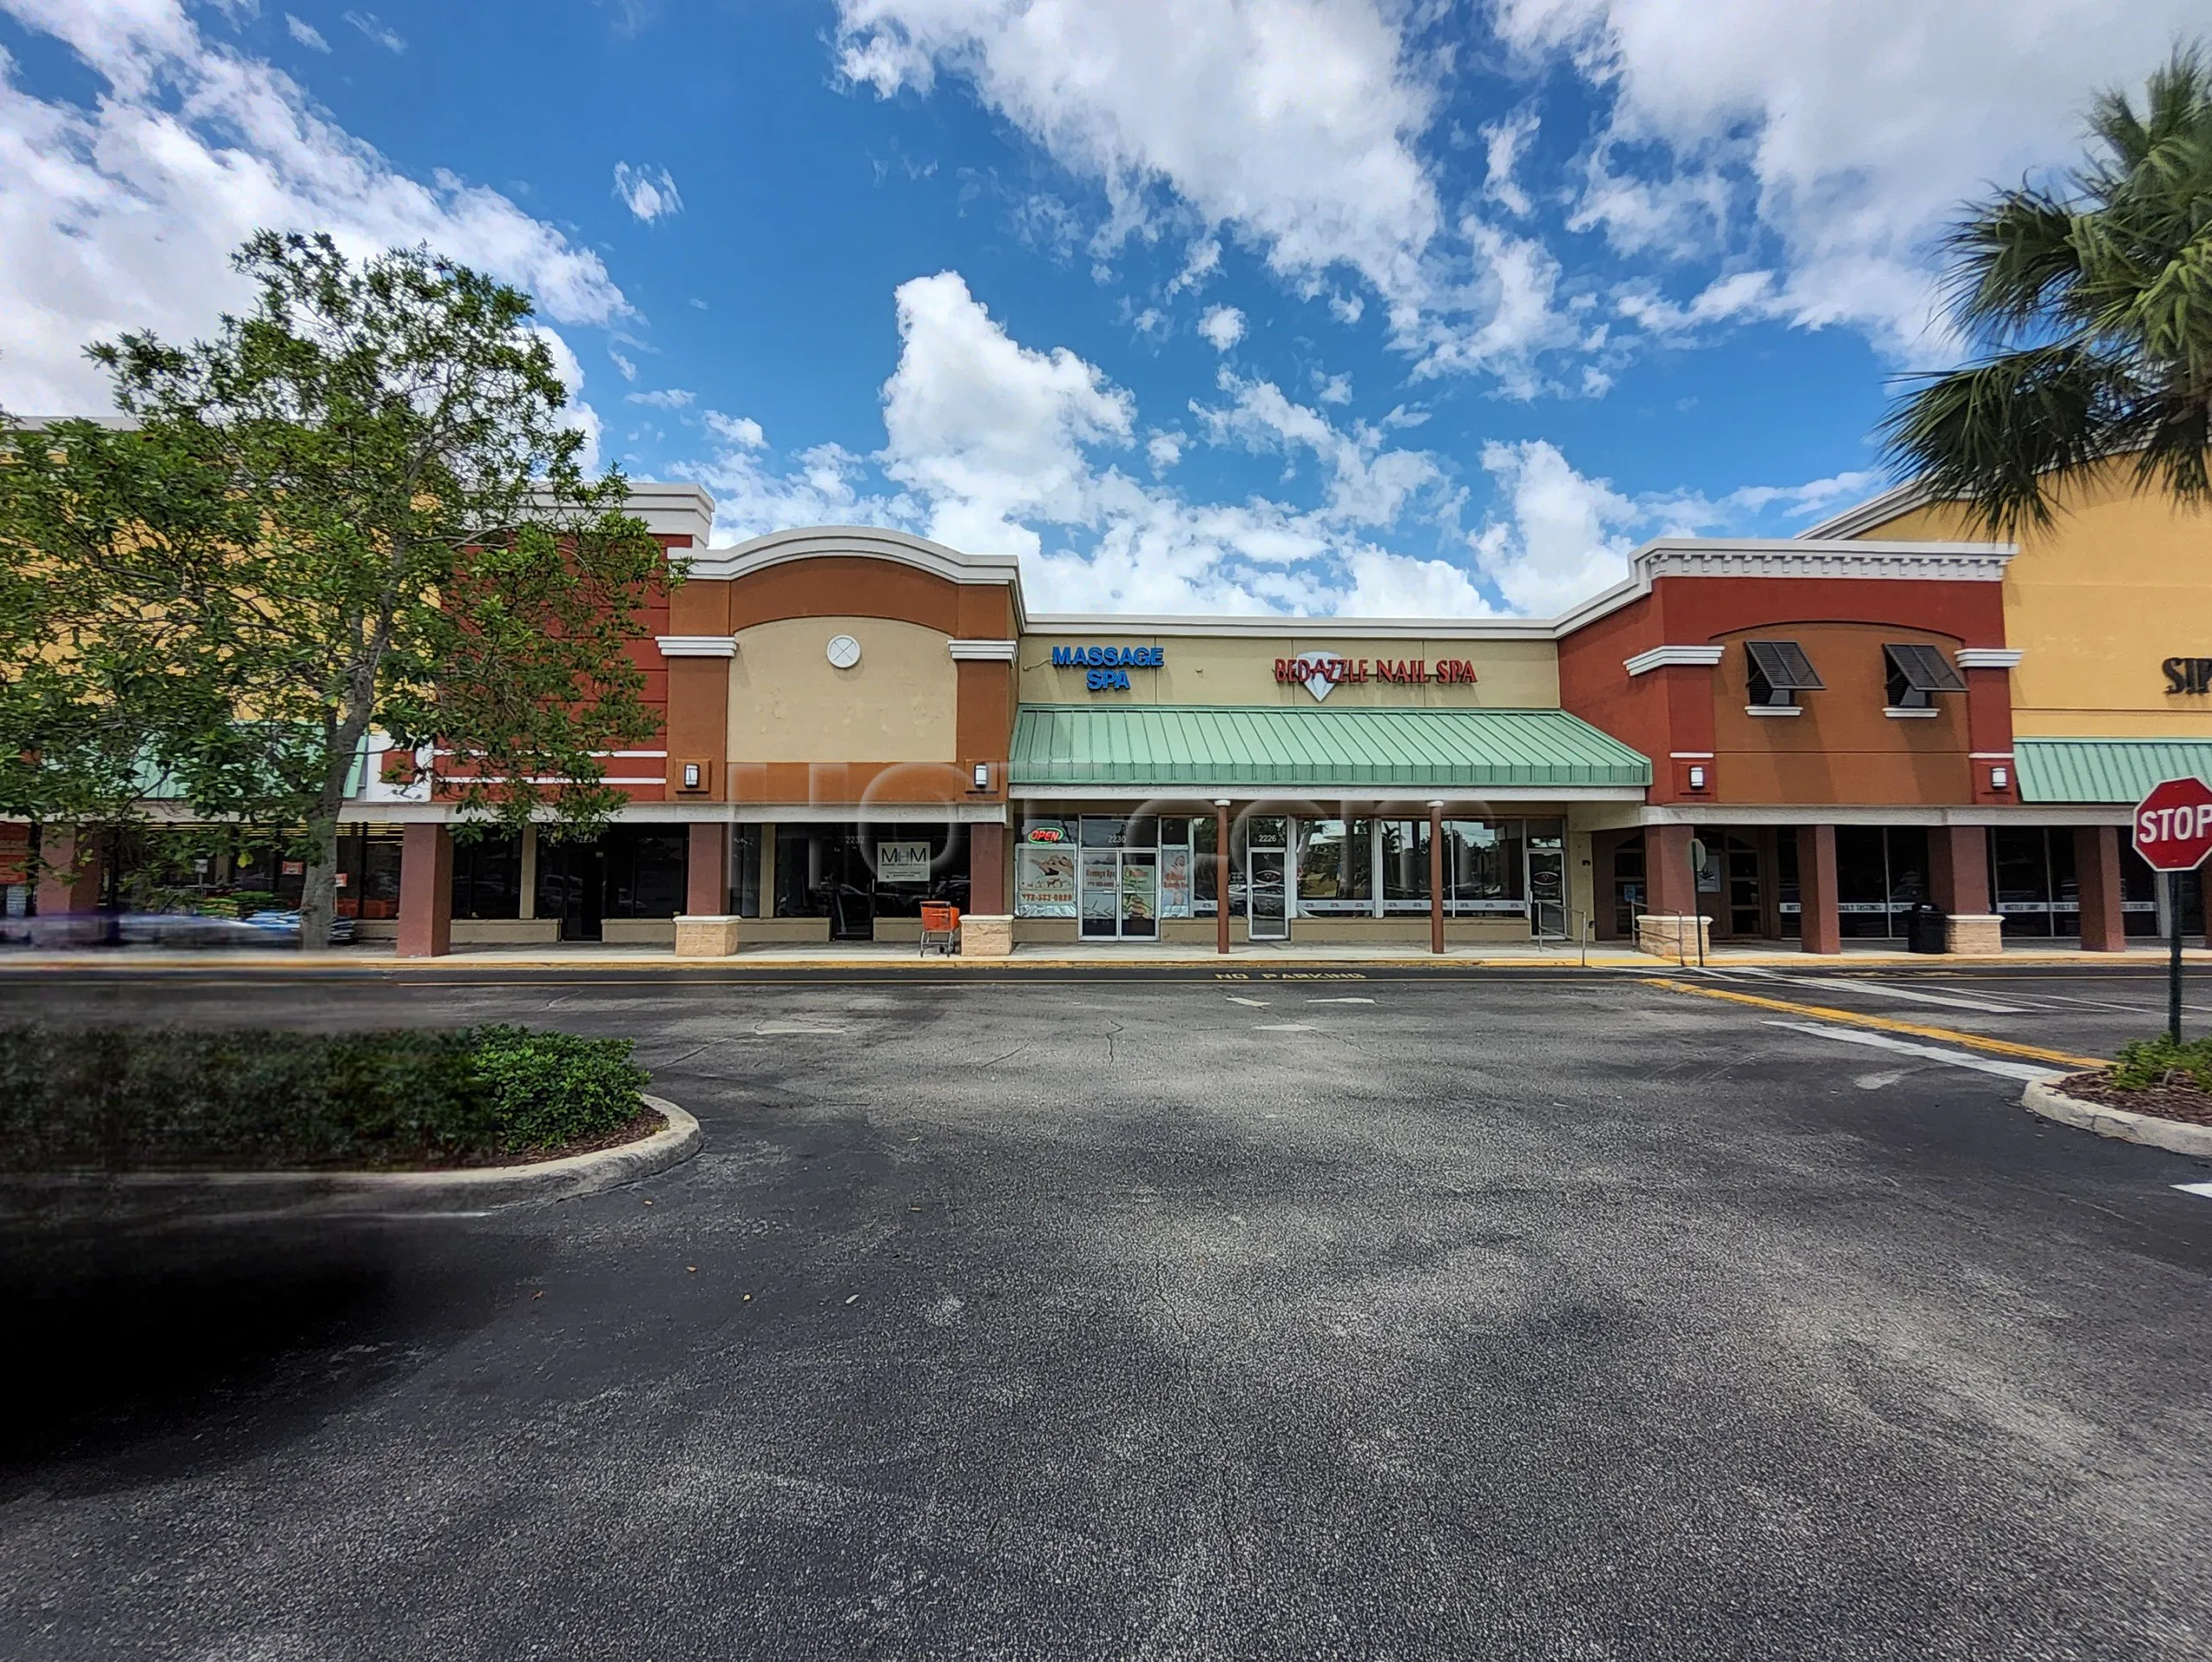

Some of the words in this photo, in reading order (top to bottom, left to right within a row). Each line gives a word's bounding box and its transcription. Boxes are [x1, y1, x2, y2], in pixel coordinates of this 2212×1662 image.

[1052, 646, 1165, 667] MASSAGE
[1275, 659, 1369, 683] BEDAZZLE
[1376, 659, 1431, 684] NAIL
[1436, 659, 1478, 684] SPA
[1086, 669, 1130, 691] SPA
[2139, 804, 2212, 844] STOP
[846, 836, 865, 844] 2232
[1031, 830, 1059, 842] OPEN
[1108, 835, 1127, 844] 2230
[1258, 834, 1277, 843] 2226
[881, 847, 926, 863] MHM
